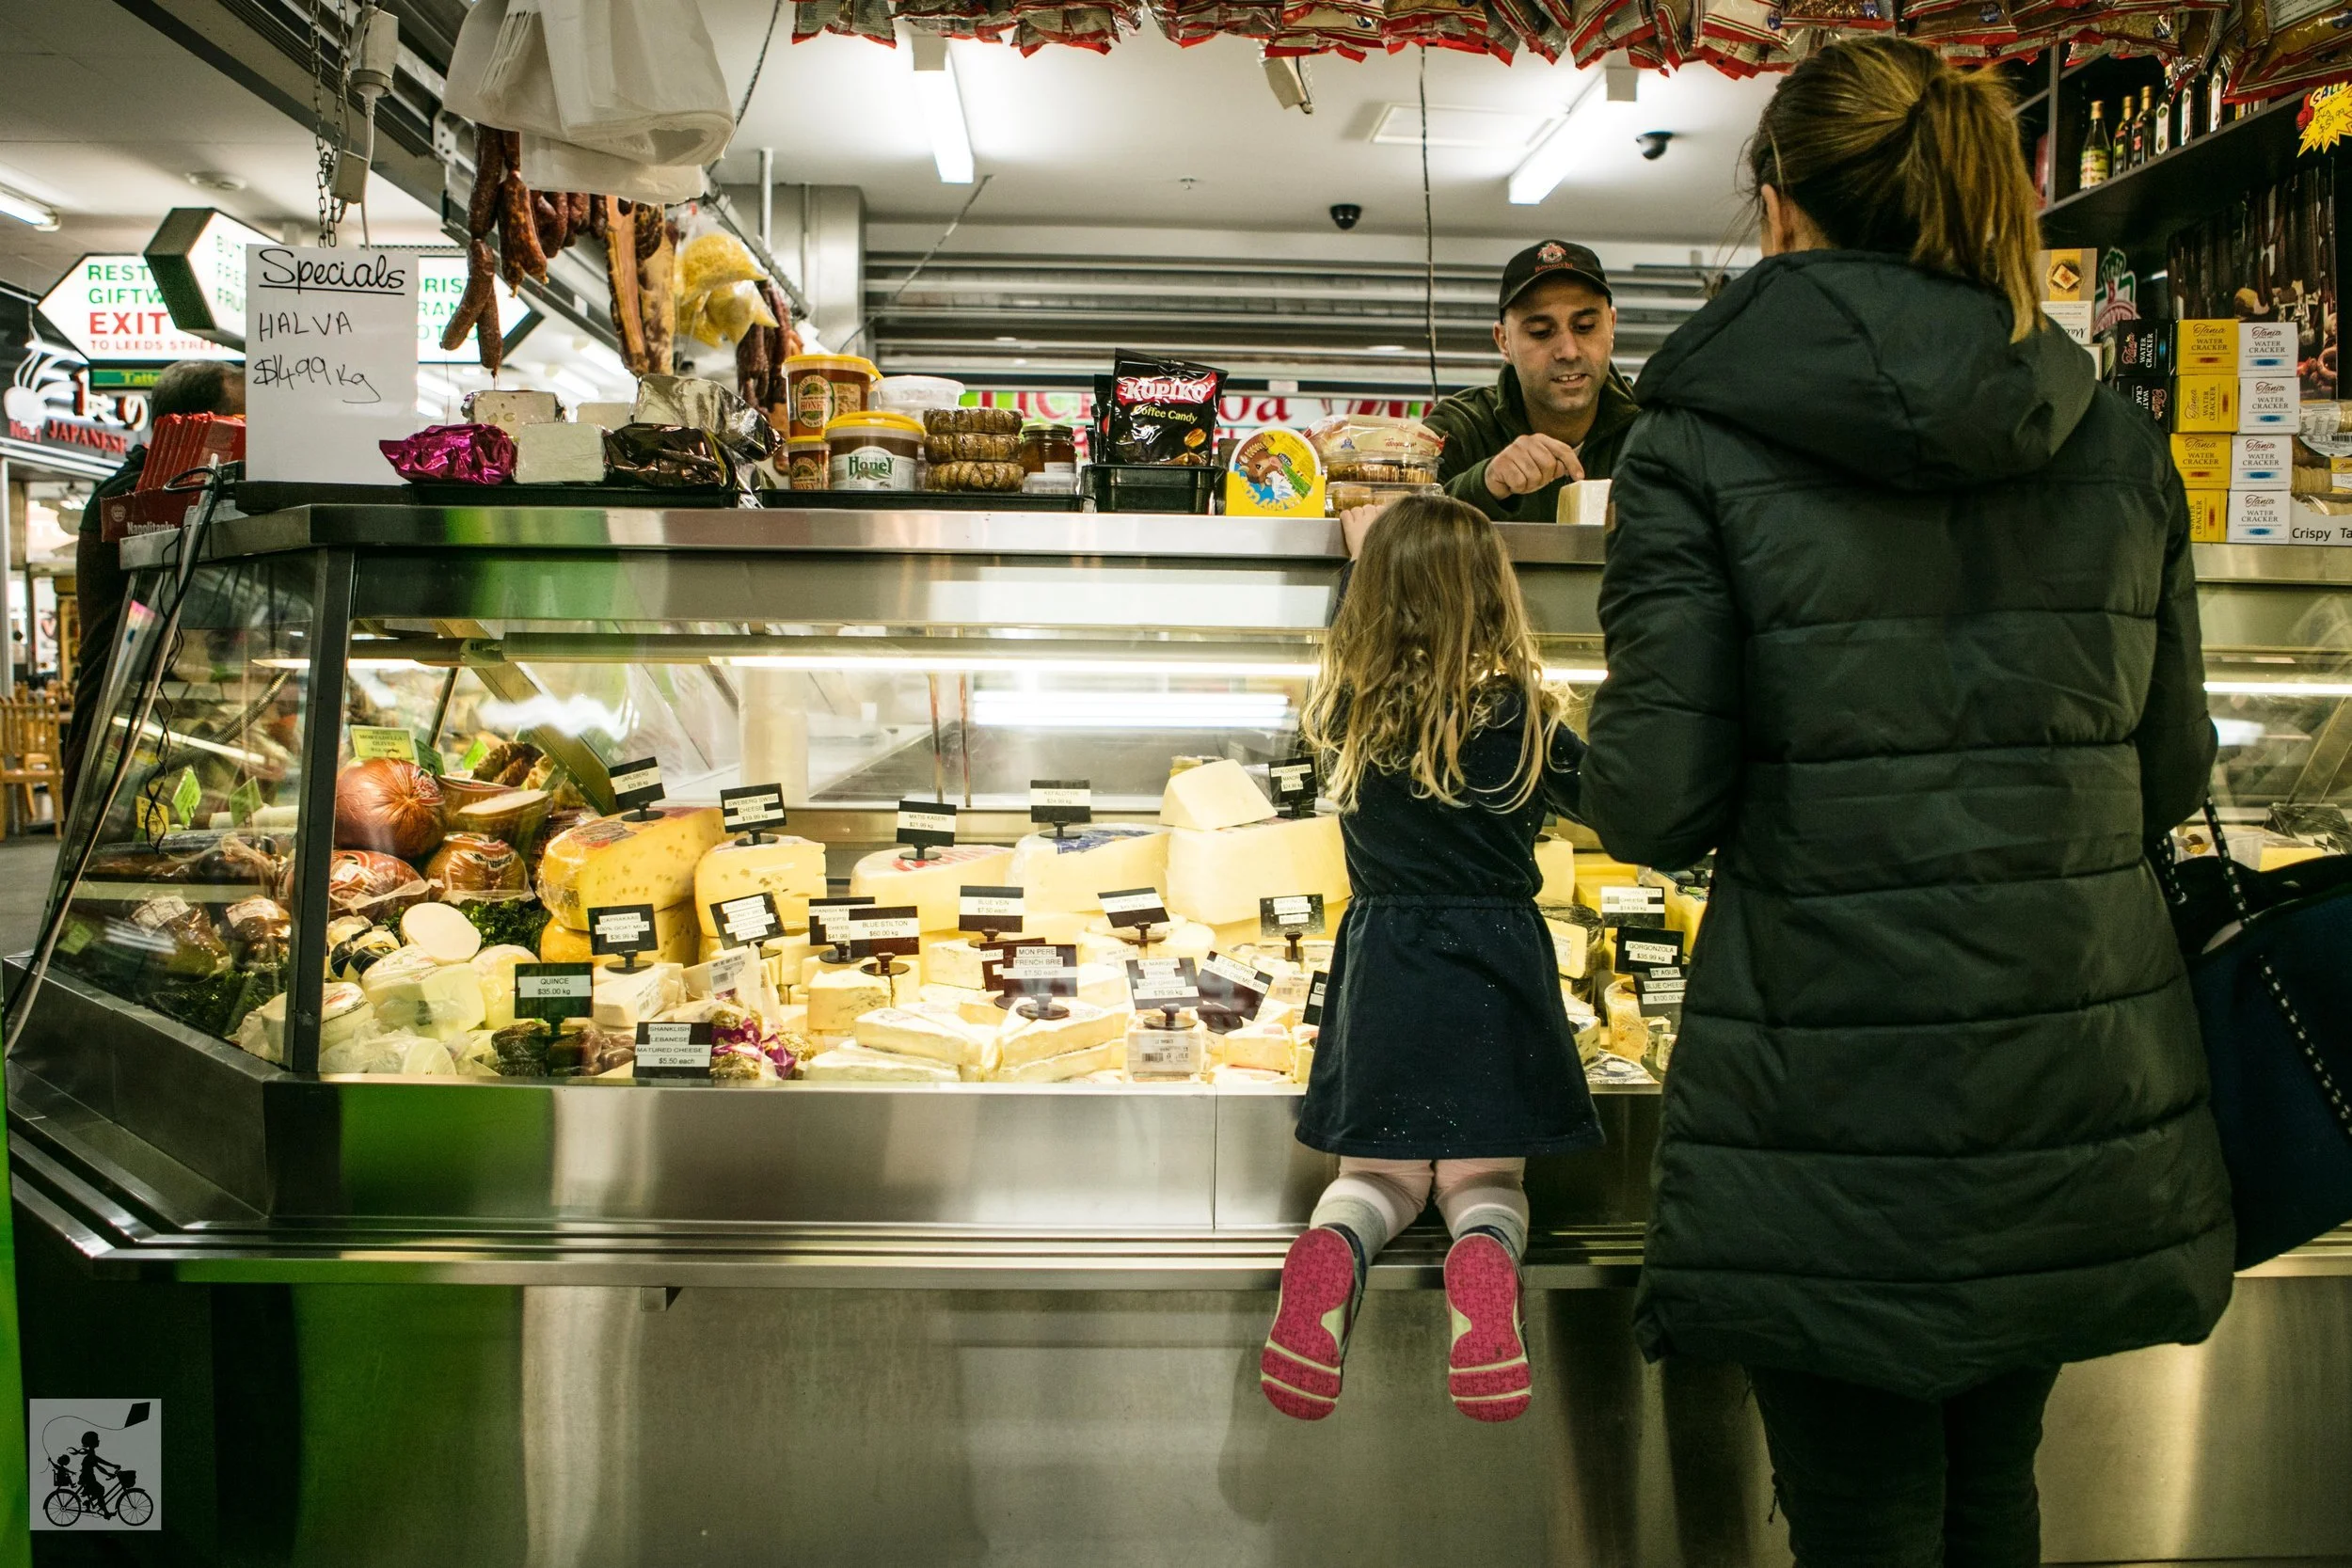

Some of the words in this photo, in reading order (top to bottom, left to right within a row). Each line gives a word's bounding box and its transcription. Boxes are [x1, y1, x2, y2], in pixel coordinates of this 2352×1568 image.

[259, 248, 405, 294] Specials
[89, 312, 167, 335] EXIT
[260, 310, 353, 341] HALVA
[90, 341, 109, 351] TO
[115, 341, 163, 351] LEEDS
[1125, 378, 1207, 403] KOPIKO
[1133, 404, 1167, 419] Coffee
[1168, 410, 1198, 424] Candy
[49, 420, 127, 454] JAPANESE
[2292, 527, 2331, 541] Crispy
[739, 805, 763, 814] CHEESE
[1629, 942, 1674, 952] GORGONZOLA
[1252, 979, 1269, 991] BRIE
